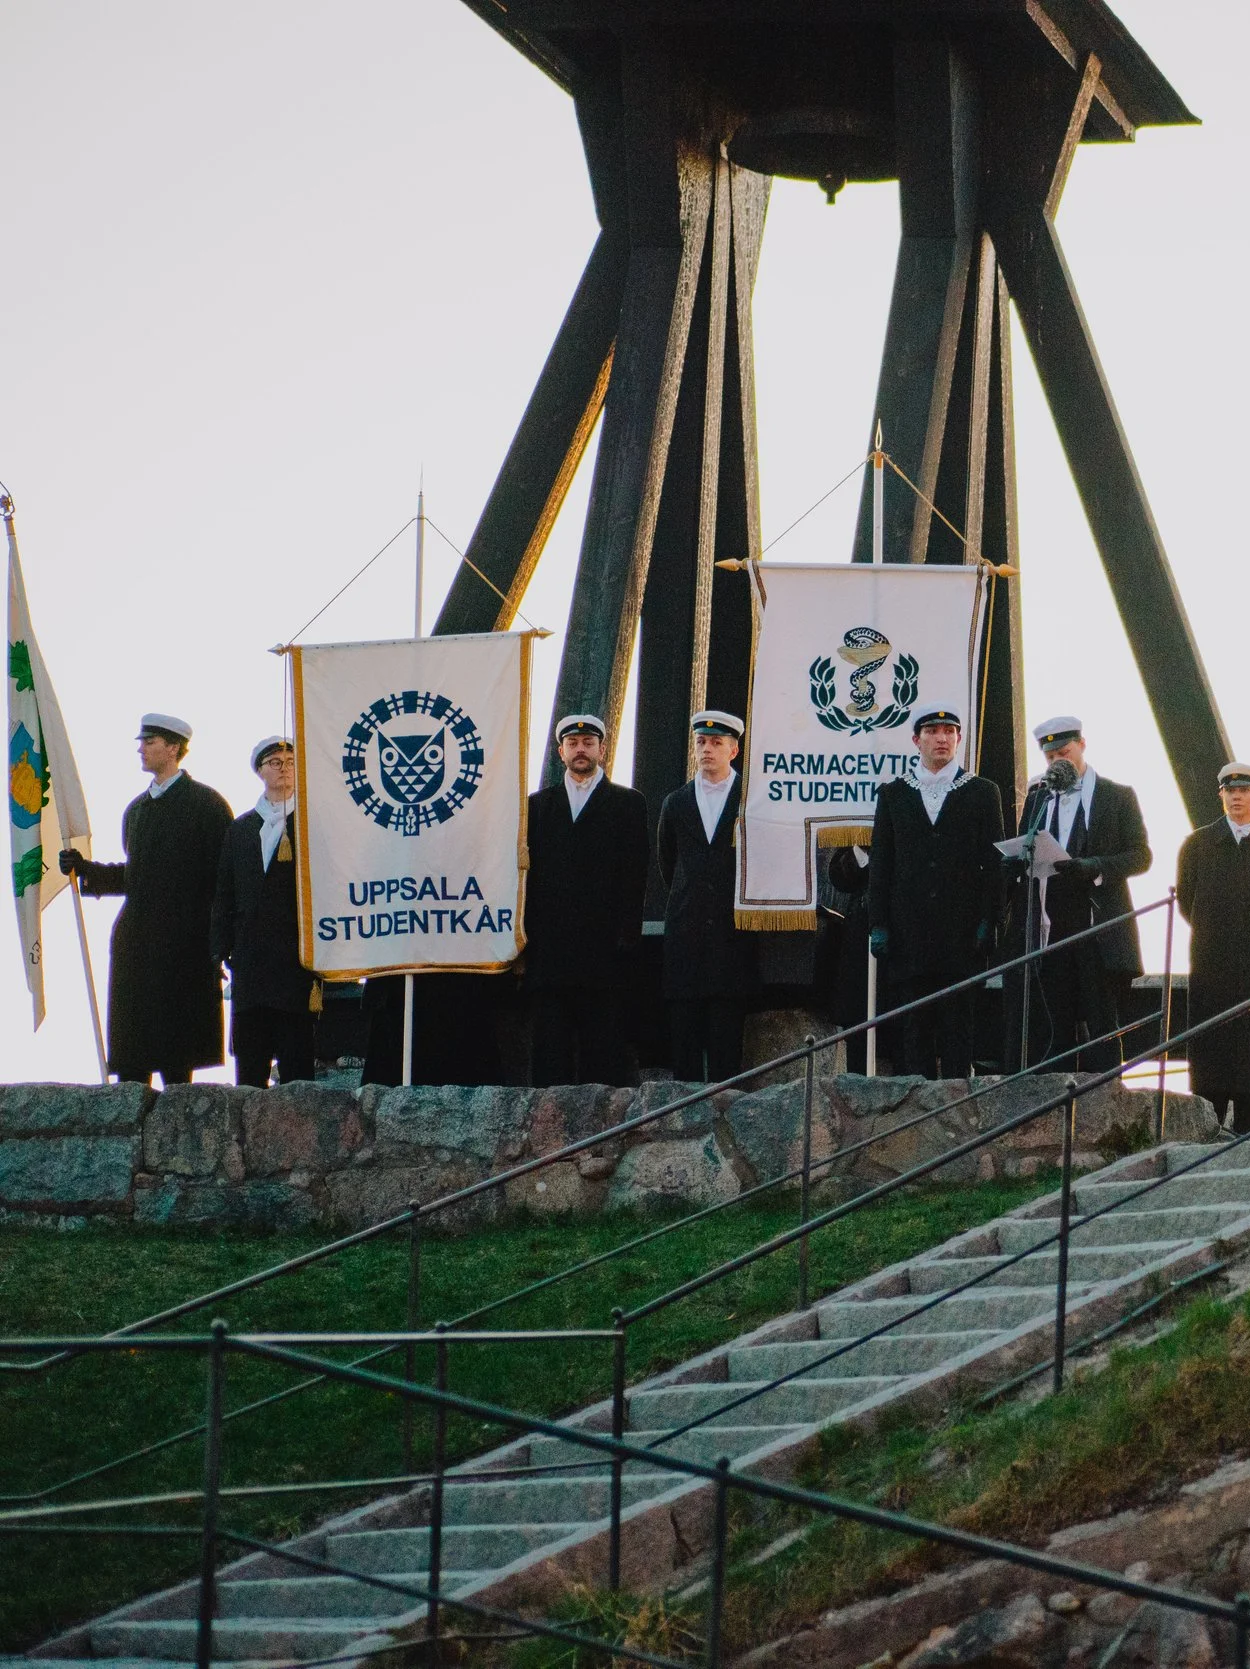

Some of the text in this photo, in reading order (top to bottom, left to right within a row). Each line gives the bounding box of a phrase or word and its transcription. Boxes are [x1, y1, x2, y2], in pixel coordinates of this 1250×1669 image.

[762, 753, 921, 775] FARMACEVTIS
[767, 781, 881, 802] STUDENTK
[349, 876, 484, 906] UPPSALA
[317, 904, 513, 941] STUDENTKÅR
